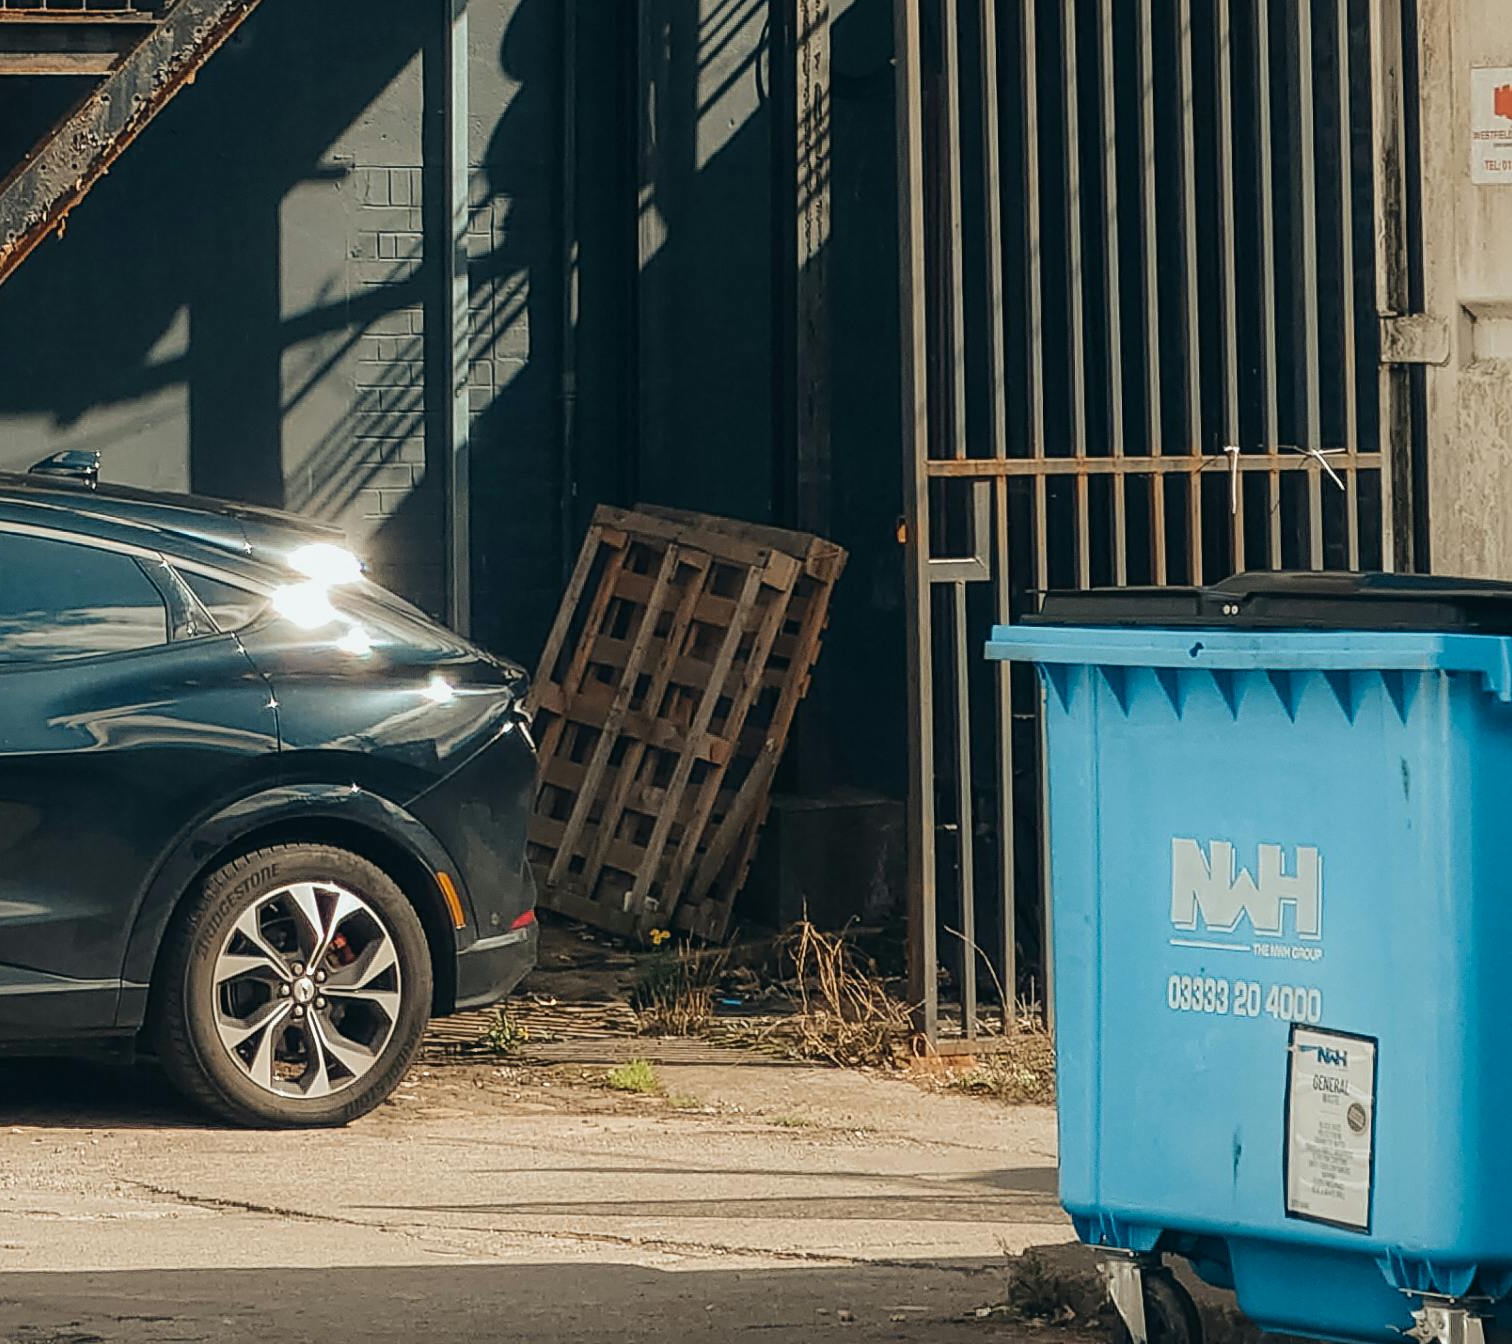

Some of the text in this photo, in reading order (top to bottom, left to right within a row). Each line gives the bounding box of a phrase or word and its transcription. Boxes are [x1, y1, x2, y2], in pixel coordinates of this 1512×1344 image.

[195, 863, 280, 961] BRIDGESTONE
[1171, 837, 1322, 941] NWH
[1168, 975, 1322, 1023] 03333 20 4000
[1317, 1047, 1347, 1067] NWH
[1313, 1073, 1350, 1097] GENERAL
